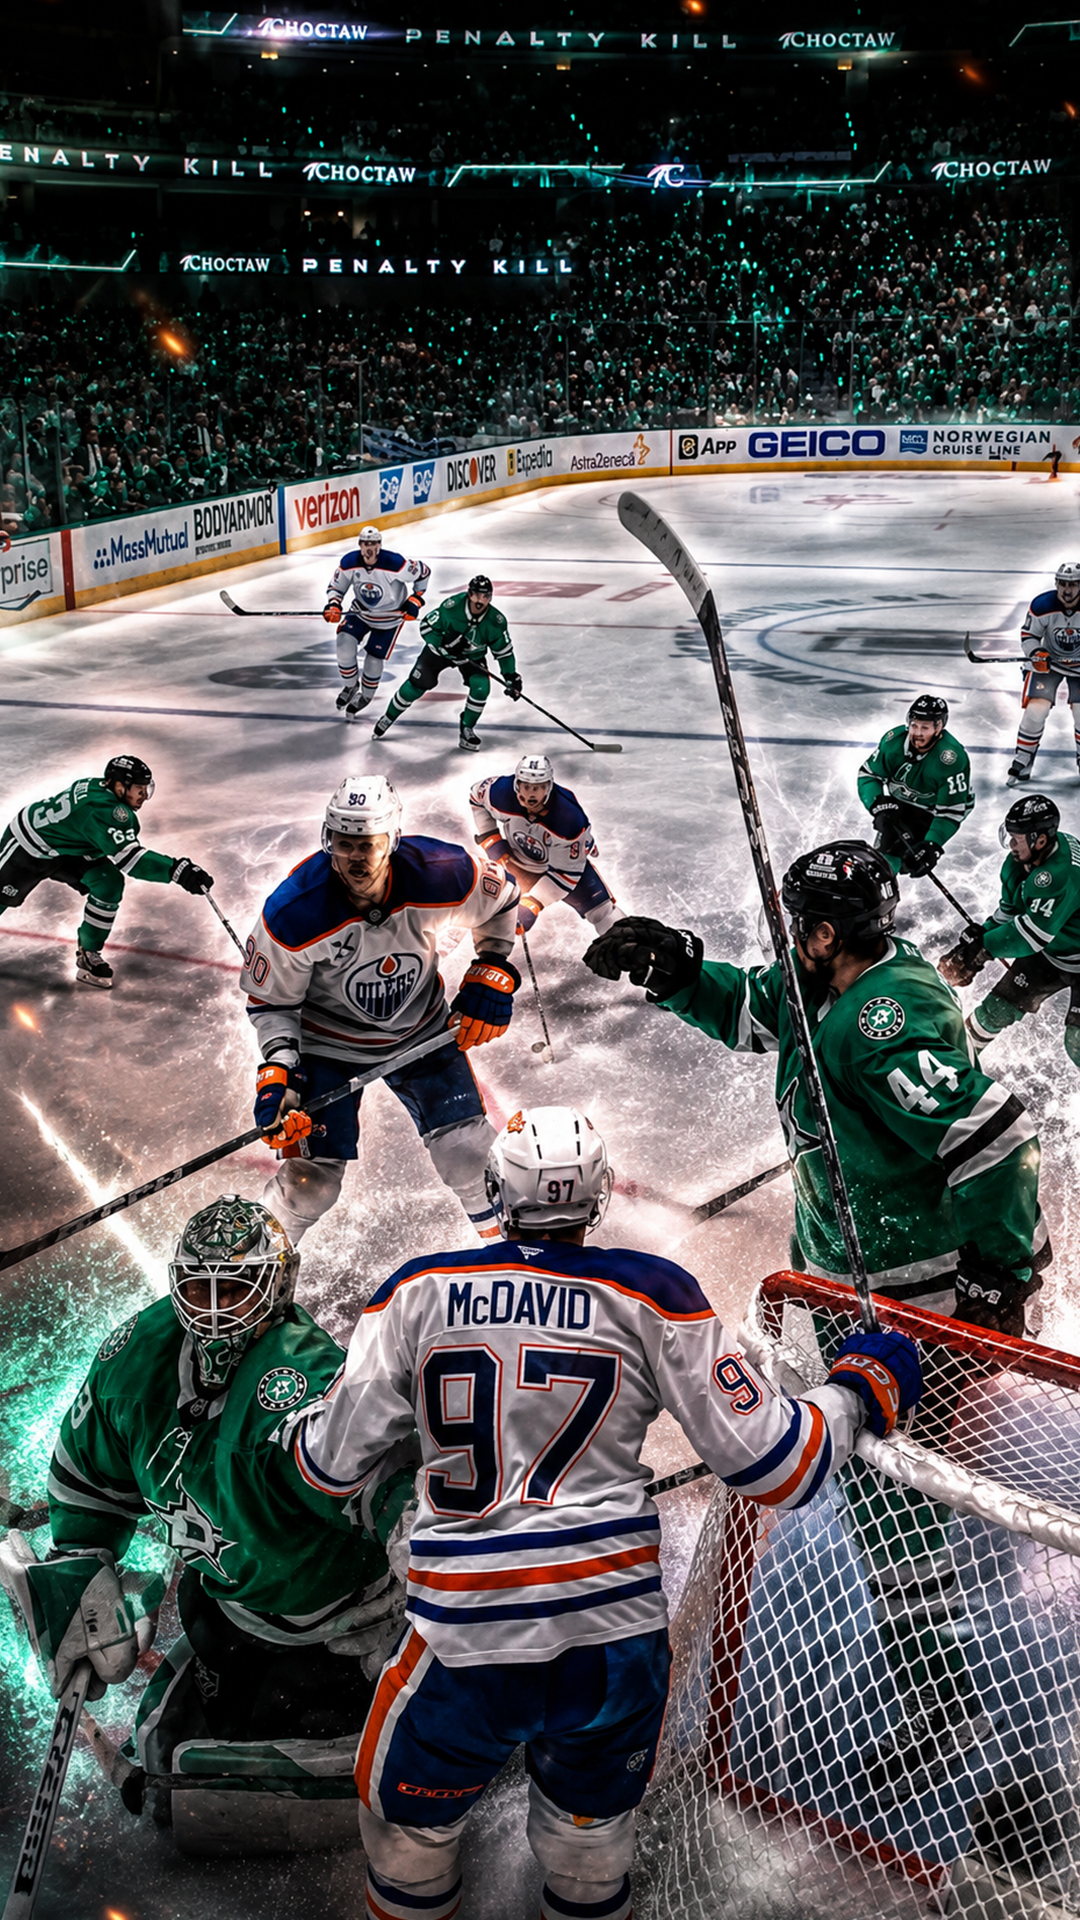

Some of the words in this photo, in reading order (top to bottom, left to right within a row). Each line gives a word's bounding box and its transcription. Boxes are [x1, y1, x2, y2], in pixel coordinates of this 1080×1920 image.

[269, 18, 368, 40] CHOCTAW
[406, 28, 605, 47] PENALTY
[641, 33, 737, 49] KILL
[789, 31, 896, 48] CHOCTAW
[0, 144, 150, 172] ENALTY
[184, 157, 273, 178] KILL
[313, 162, 416, 183] CHOCTAW
[942, 158, 1051, 180] CHOCTAW
[187, 255, 271, 273] CHOCTAW
[302, 258, 467, 274] PENALTY
[493, 258, 572, 274] KILL
[748, 430, 886, 459] GEICO
[933, 430, 1051, 444] NORWEGIAN
[933, 445, 983, 455] CRUISE
[989, 445, 1021, 456] LINE
[447, 454, 496, 492] DISCOVER
[194, 494, 275, 541] BODYARMOR
[294, 482, 361, 531] verizon
[110, 521, 189, 566] MassMutual
[1, 555, 48, 594] prise
[887, 1049, 960, 1115] 44
[547, 1178, 575, 1204] 97
[447, 1280, 592, 1331] McDAVID
[420, 1343, 622, 1520] 97
